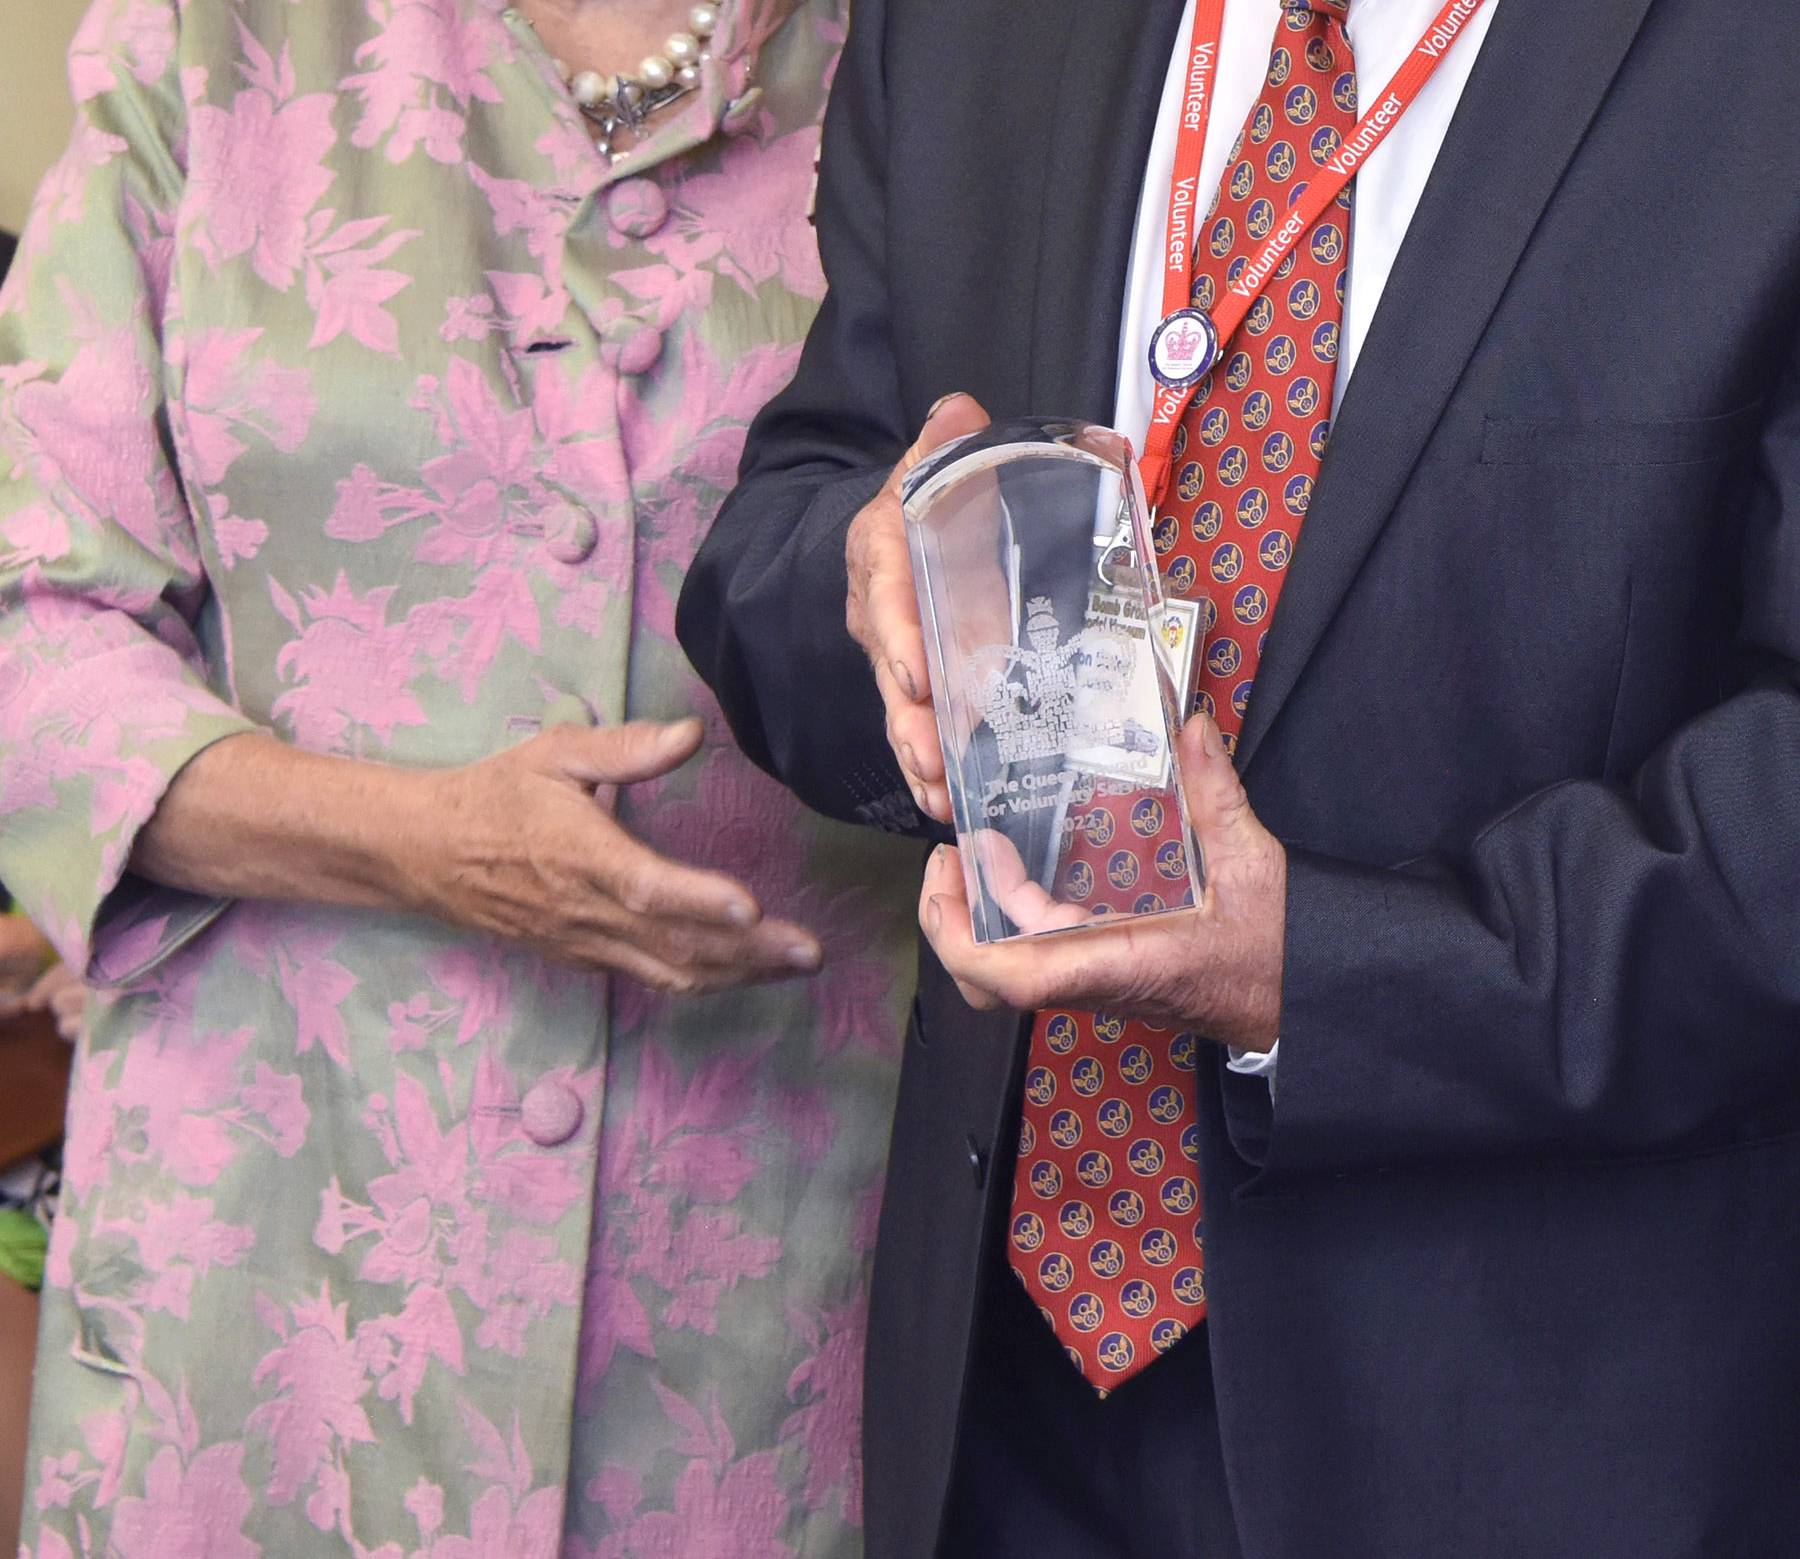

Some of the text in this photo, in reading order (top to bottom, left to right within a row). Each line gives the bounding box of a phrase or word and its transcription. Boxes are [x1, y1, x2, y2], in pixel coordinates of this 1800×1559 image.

[1184, 41, 1215, 132] Volunteer
[1327, 91, 1402, 176] Volunteer
[1168, 176, 1196, 274] Volunteer
[1232, 209, 1305, 298] Volunteer
[982, 799, 1007, 819] for
[985, 778, 1020, 795] The
